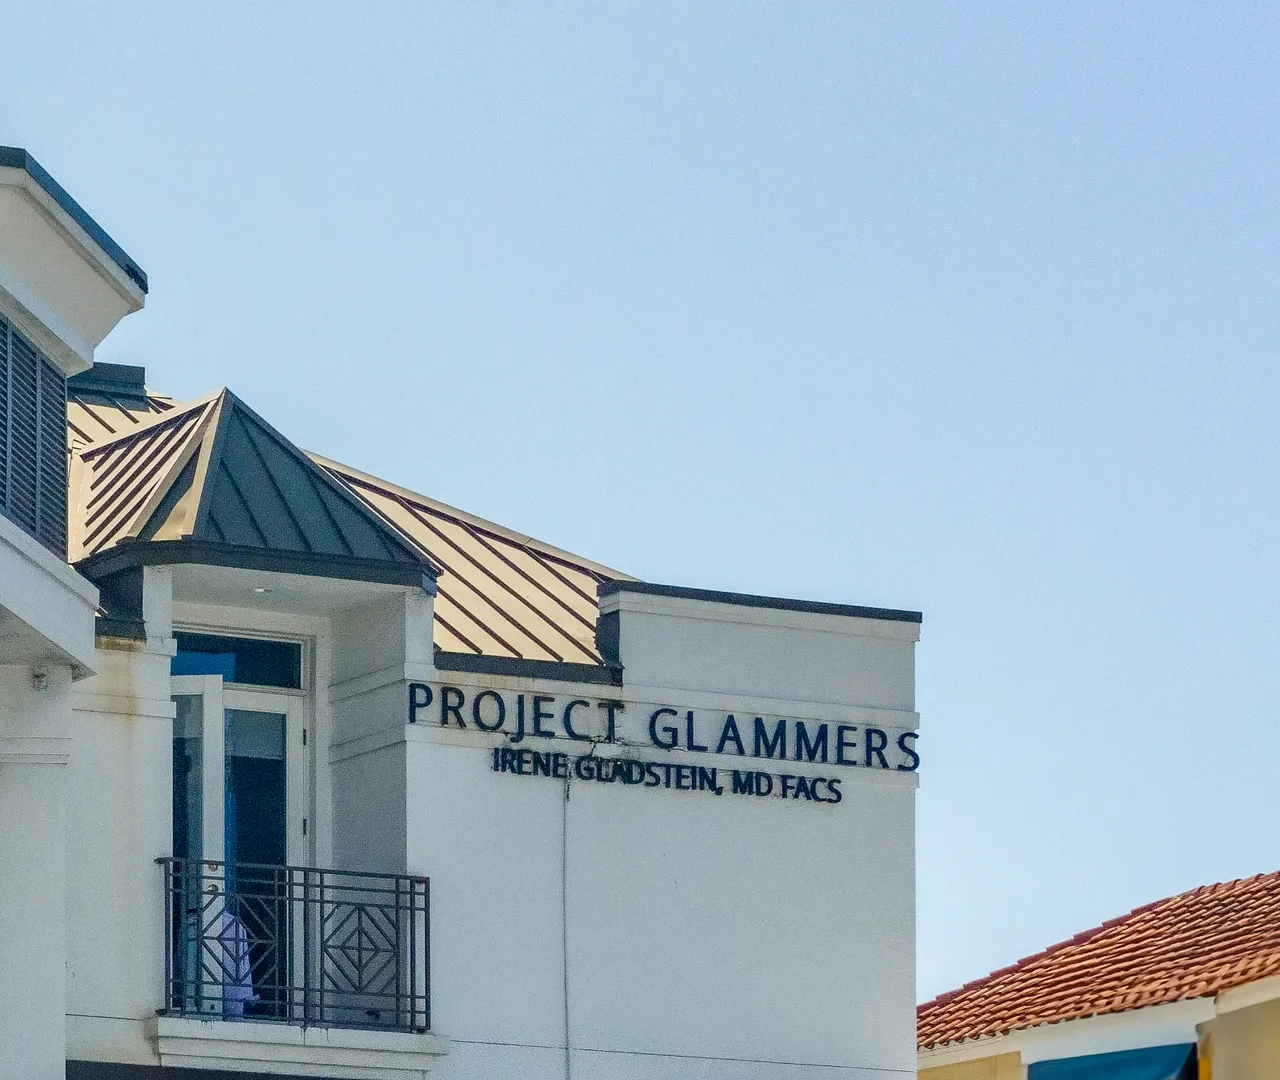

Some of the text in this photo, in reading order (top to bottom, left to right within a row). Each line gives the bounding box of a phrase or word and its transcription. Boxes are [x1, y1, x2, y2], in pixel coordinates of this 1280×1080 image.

[408, 682, 920, 772] PROJECT GLAMMERS
[492, 747, 843, 803] IRENE GLADSTEIN, MD FACS
